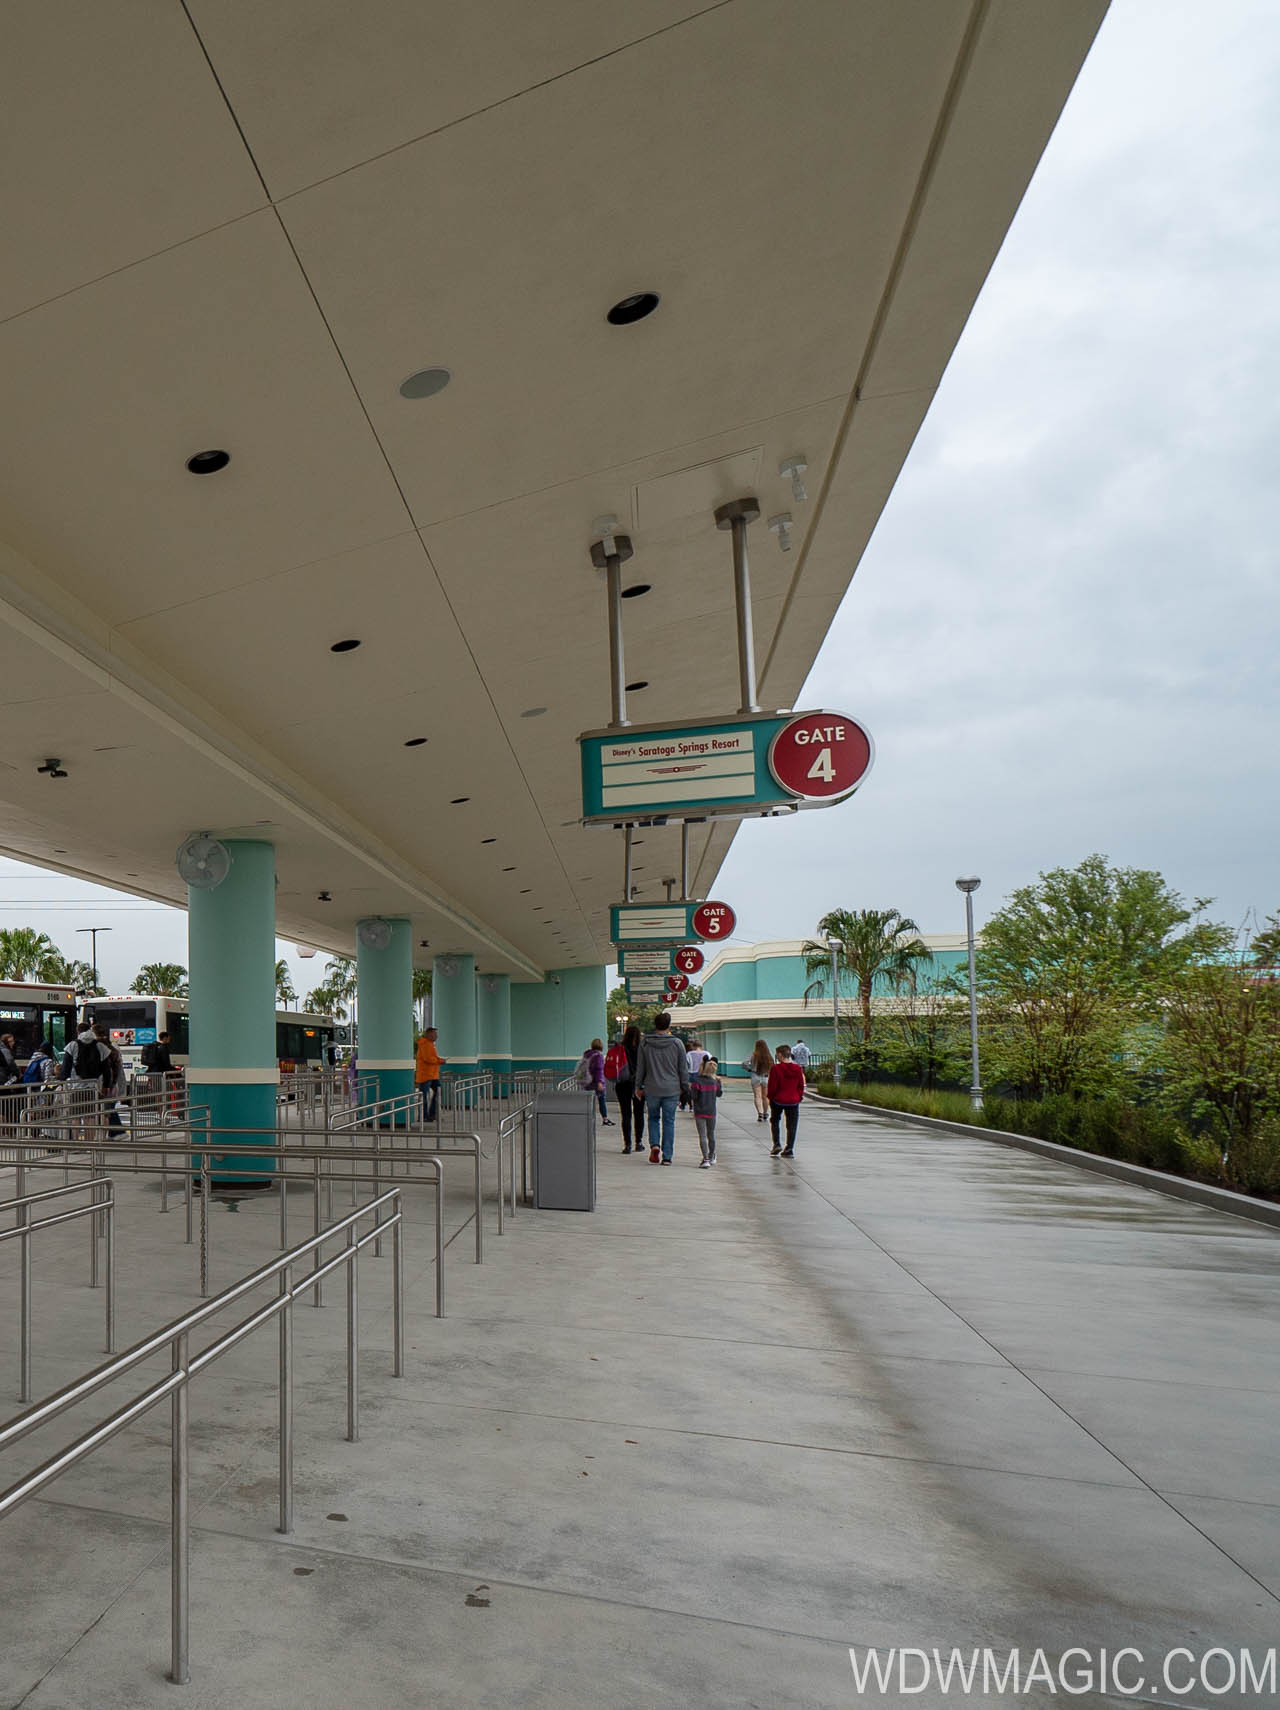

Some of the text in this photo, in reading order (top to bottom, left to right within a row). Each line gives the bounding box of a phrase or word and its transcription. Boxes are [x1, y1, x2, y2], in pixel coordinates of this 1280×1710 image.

[794, 726, 845, 745] GATE
[612, 739, 740, 757] Disney's Saratoga Springs Resort
[807, 747, 836, 783] 4
[703, 908, 726, 917] GATE
[708, 917, 720, 934] 5
[684, 957, 694, 969] 6
[674, 980, 682, 990] 7
